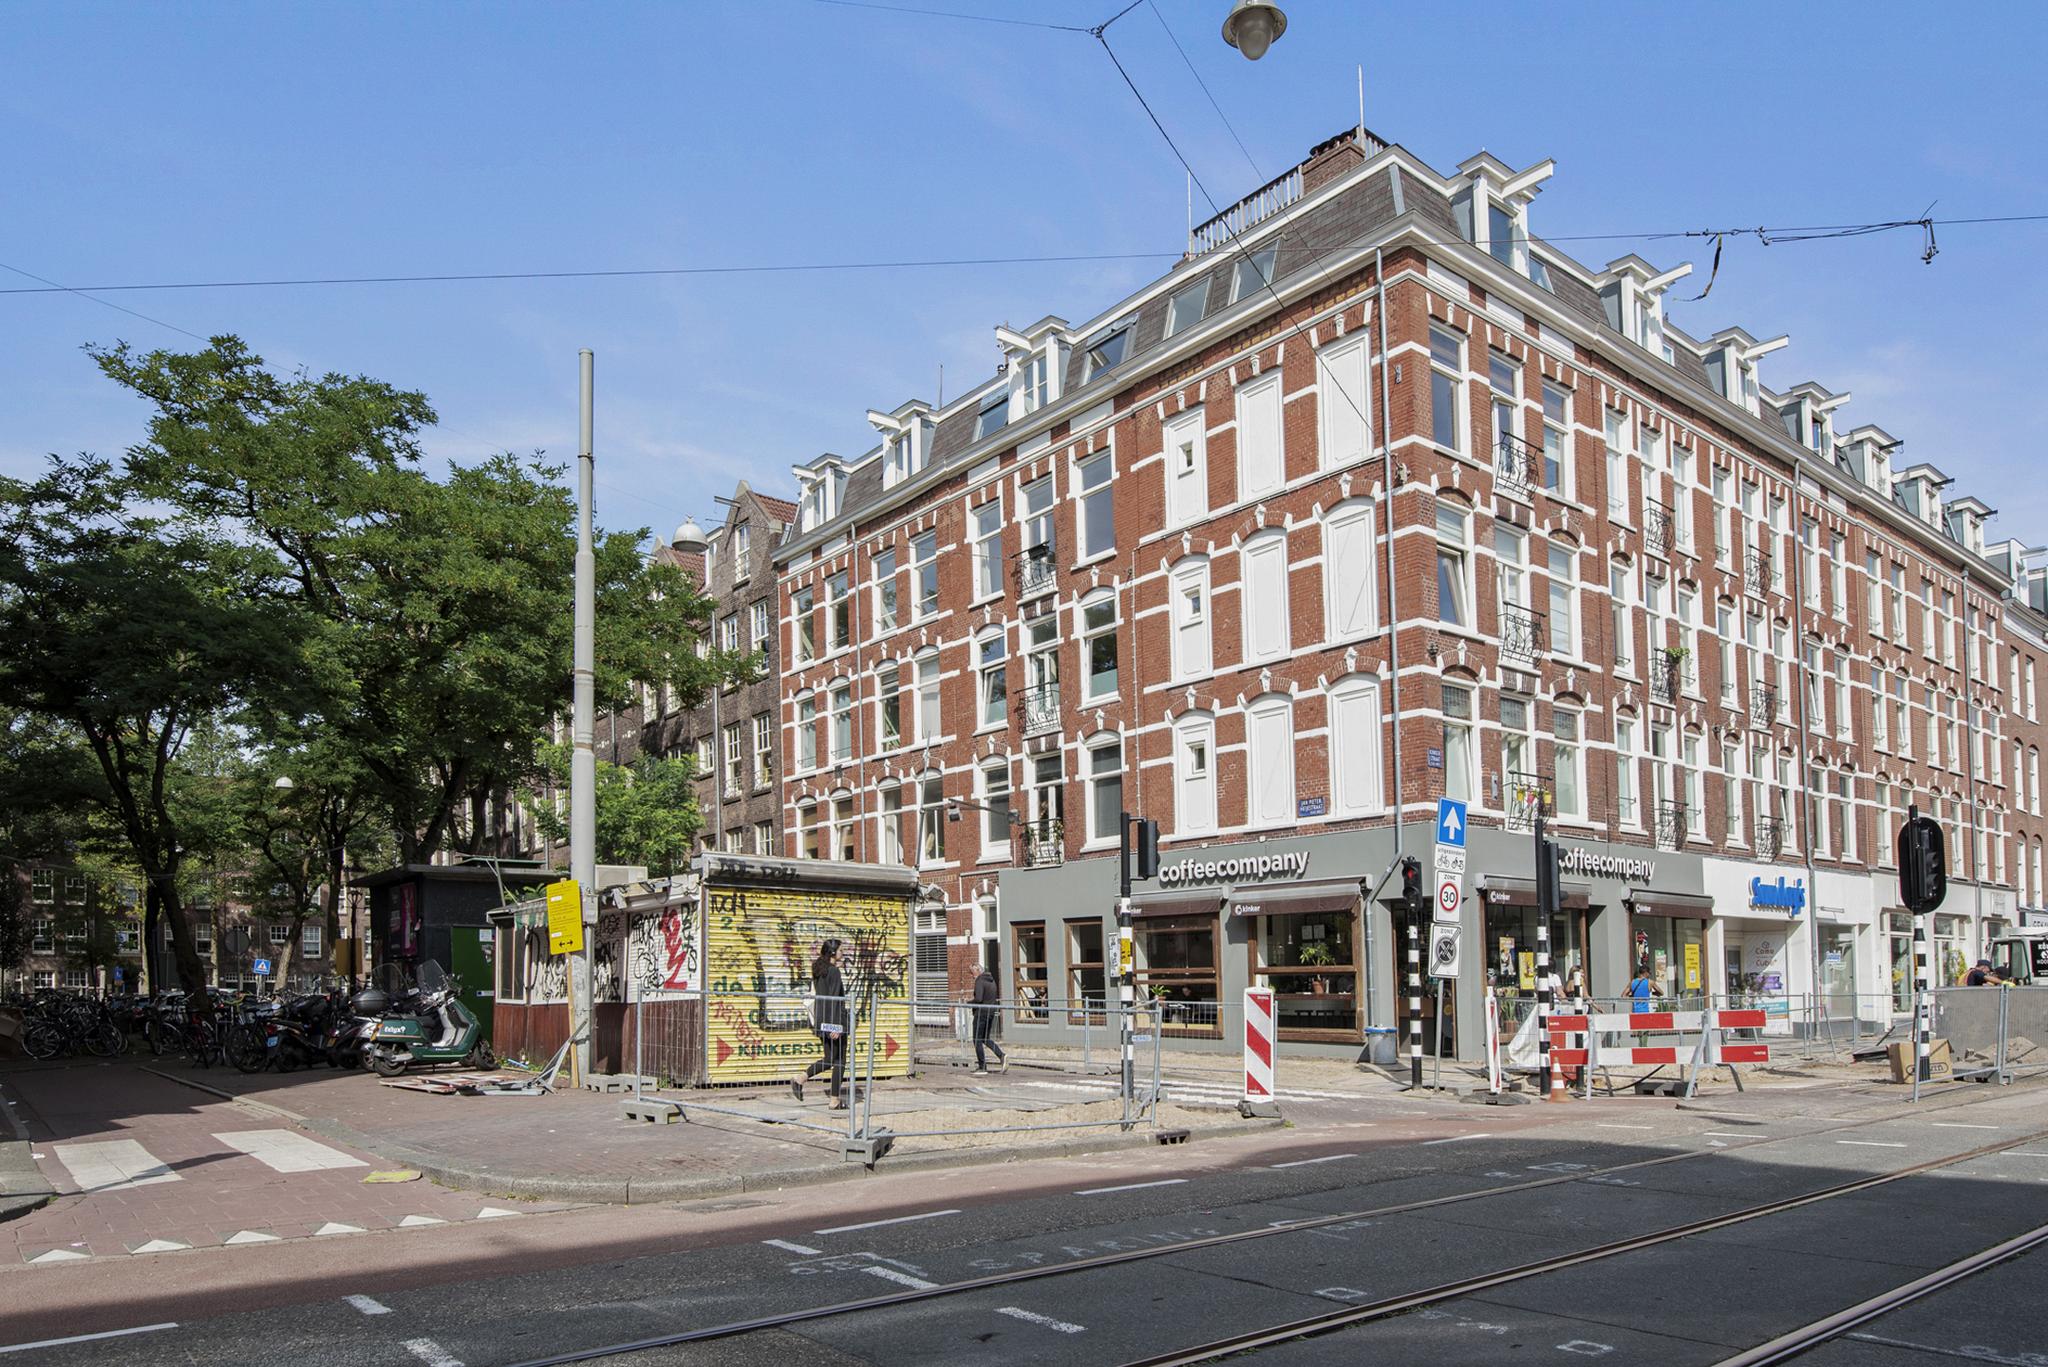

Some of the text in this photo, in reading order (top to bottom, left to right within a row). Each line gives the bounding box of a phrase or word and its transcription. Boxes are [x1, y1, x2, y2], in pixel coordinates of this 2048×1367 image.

[1159, 851, 1310, 882] coffeecompany
[1443, 873, 1456, 881] ZONE
[1443, 891, 1456, 904] 30
[1242, 905, 1261, 913] kinker
[1440, 927, 1454, 935] ZONE
[738, 1042, 867, 1057] KINKERSTAT
